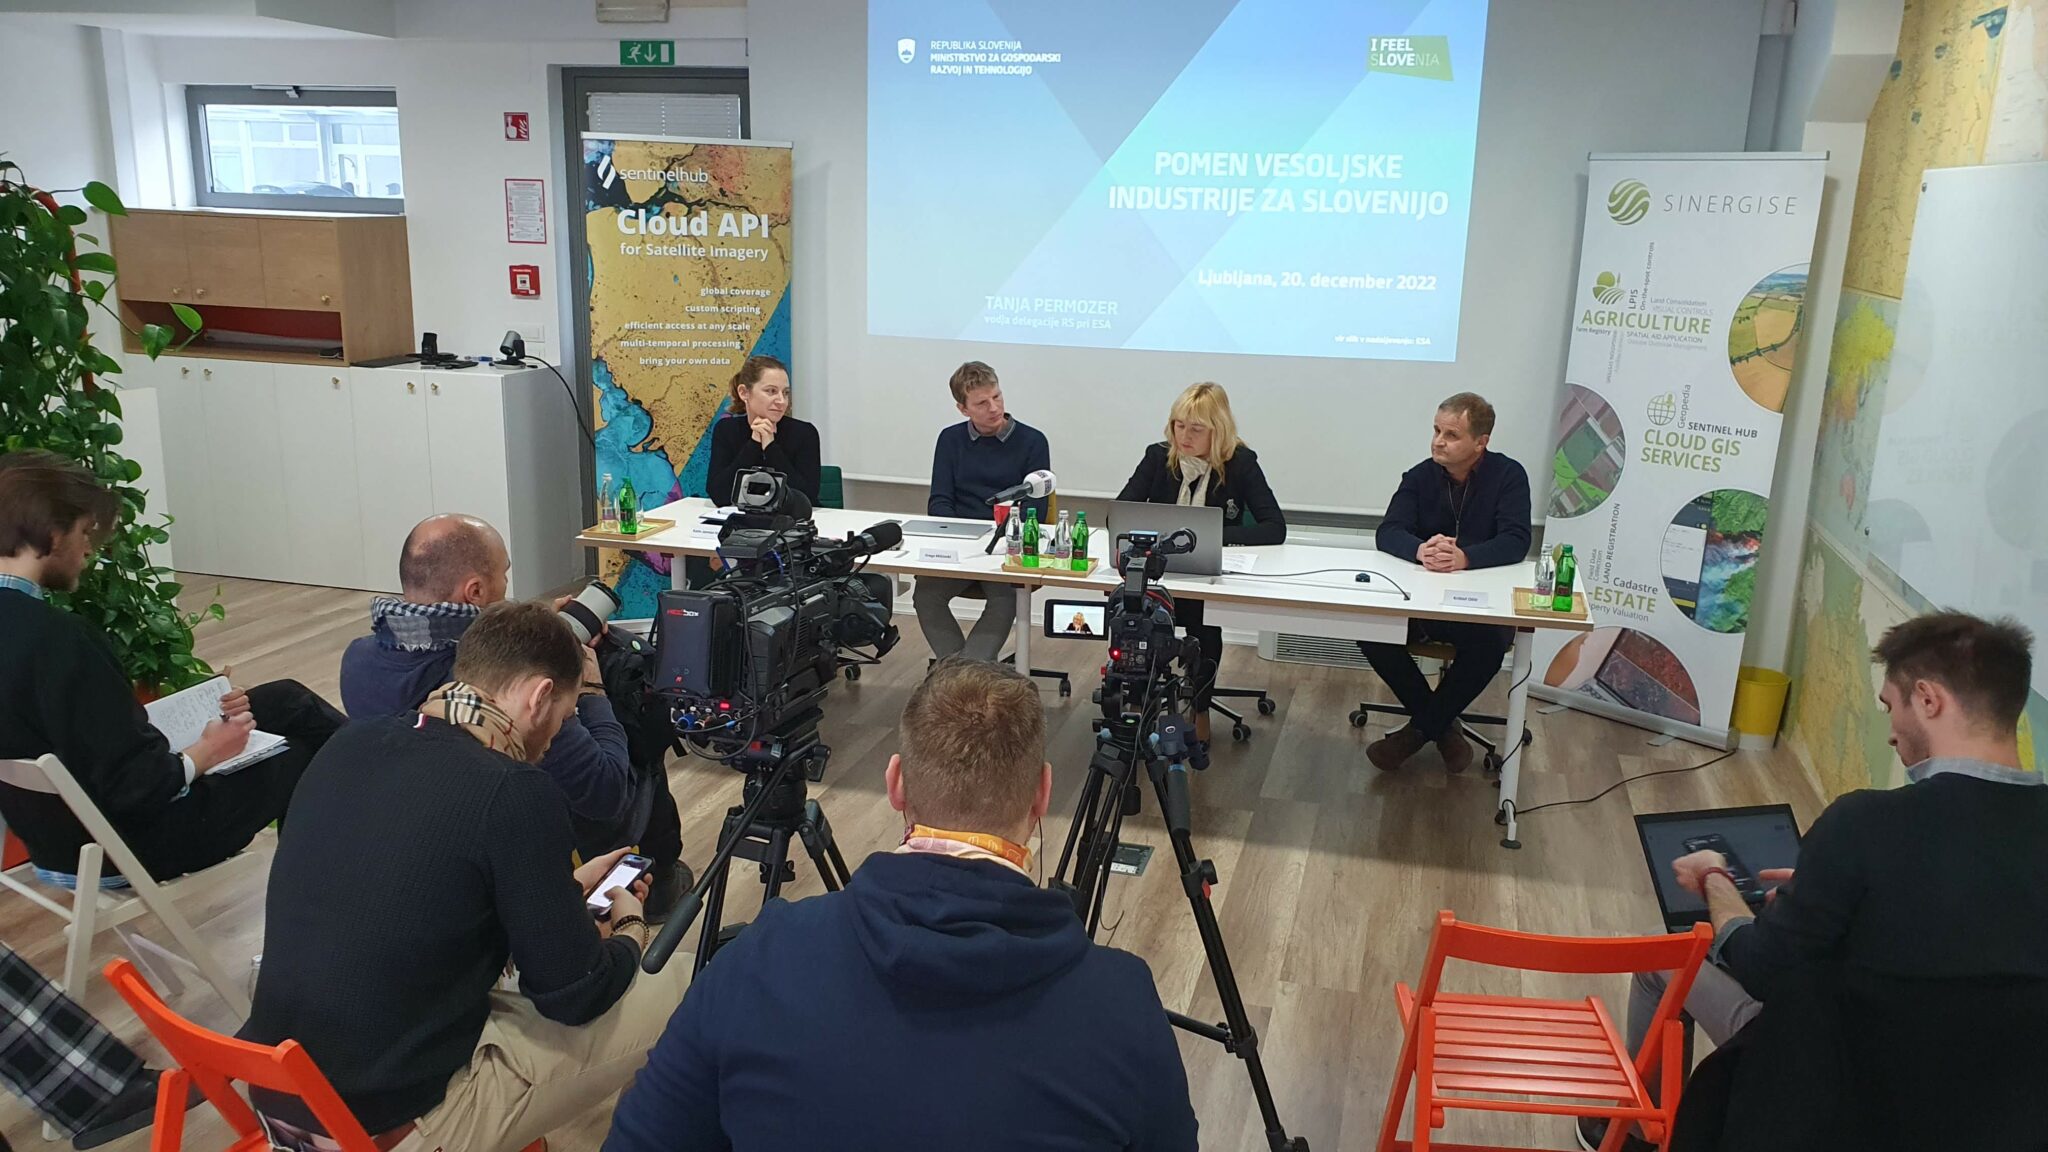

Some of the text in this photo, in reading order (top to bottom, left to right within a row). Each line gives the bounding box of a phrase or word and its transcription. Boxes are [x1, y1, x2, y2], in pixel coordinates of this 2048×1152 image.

[930, 40, 1022, 52] REPUBLIKA SLOVENIJA
[1371, 38, 1414, 52] I FEEL
[930, 53, 1061, 63] MINISTRSTVO ZA GOSPODARSKI
[1370, 53, 1440, 67] SLOVENIA
[930, 65, 1033, 77] RAZVOJ IN TEHNOLOGIJO
[619, 167, 709, 183] sentinelhub
[1154, 151, 1404, 183] POMEN VESOLJSKE
[1109, 185, 1449, 221] INDUSTRIJE ZA SLOVENIJO
[1663, 194, 1798, 216] SINERGISE
[617, 208, 769, 239] Cloud API
[620, 243, 769, 261] for Satellite Imagery
[1199, 269, 1437, 291] Ljubljana, 20. december 2022
[700, 287, 771, 298] global coverage
[1628, 288, 1639, 310] LPIS
[685, 305, 761, 315] custom scripting
[985, 295, 1118, 315] TANJA PERMOZER
[624, 321, 750, 332] efficient access at any scale
[984, 314, 1112, 330] vodja delegacije RS pri ESA
[1581, 309, 1712, 335] AGRICULTURE
[620, 339, 741, 350] multi-temporal processing
[1626, 331, 1650, 340] SPATIAL
[1651, 333, 1662, 341] AID
[1662, 334, 1703, 344] APPLICATION
[639, 357, 730, 367] bring your own data
[1677, 384, 1691, 429] Geopedia
[1688, 421, 1758, 439] SENTINEL HUB
[1644, 428, 1741, 457] CLOUD GIS
[1640, 446, 1722, 474] SERVICES
[1603, 503, 1621, 584] LAND REGISTRATION
[1613, 577, 1658, 595] Cadastre
[1589, 602, 1649, 622] perty Valuation
